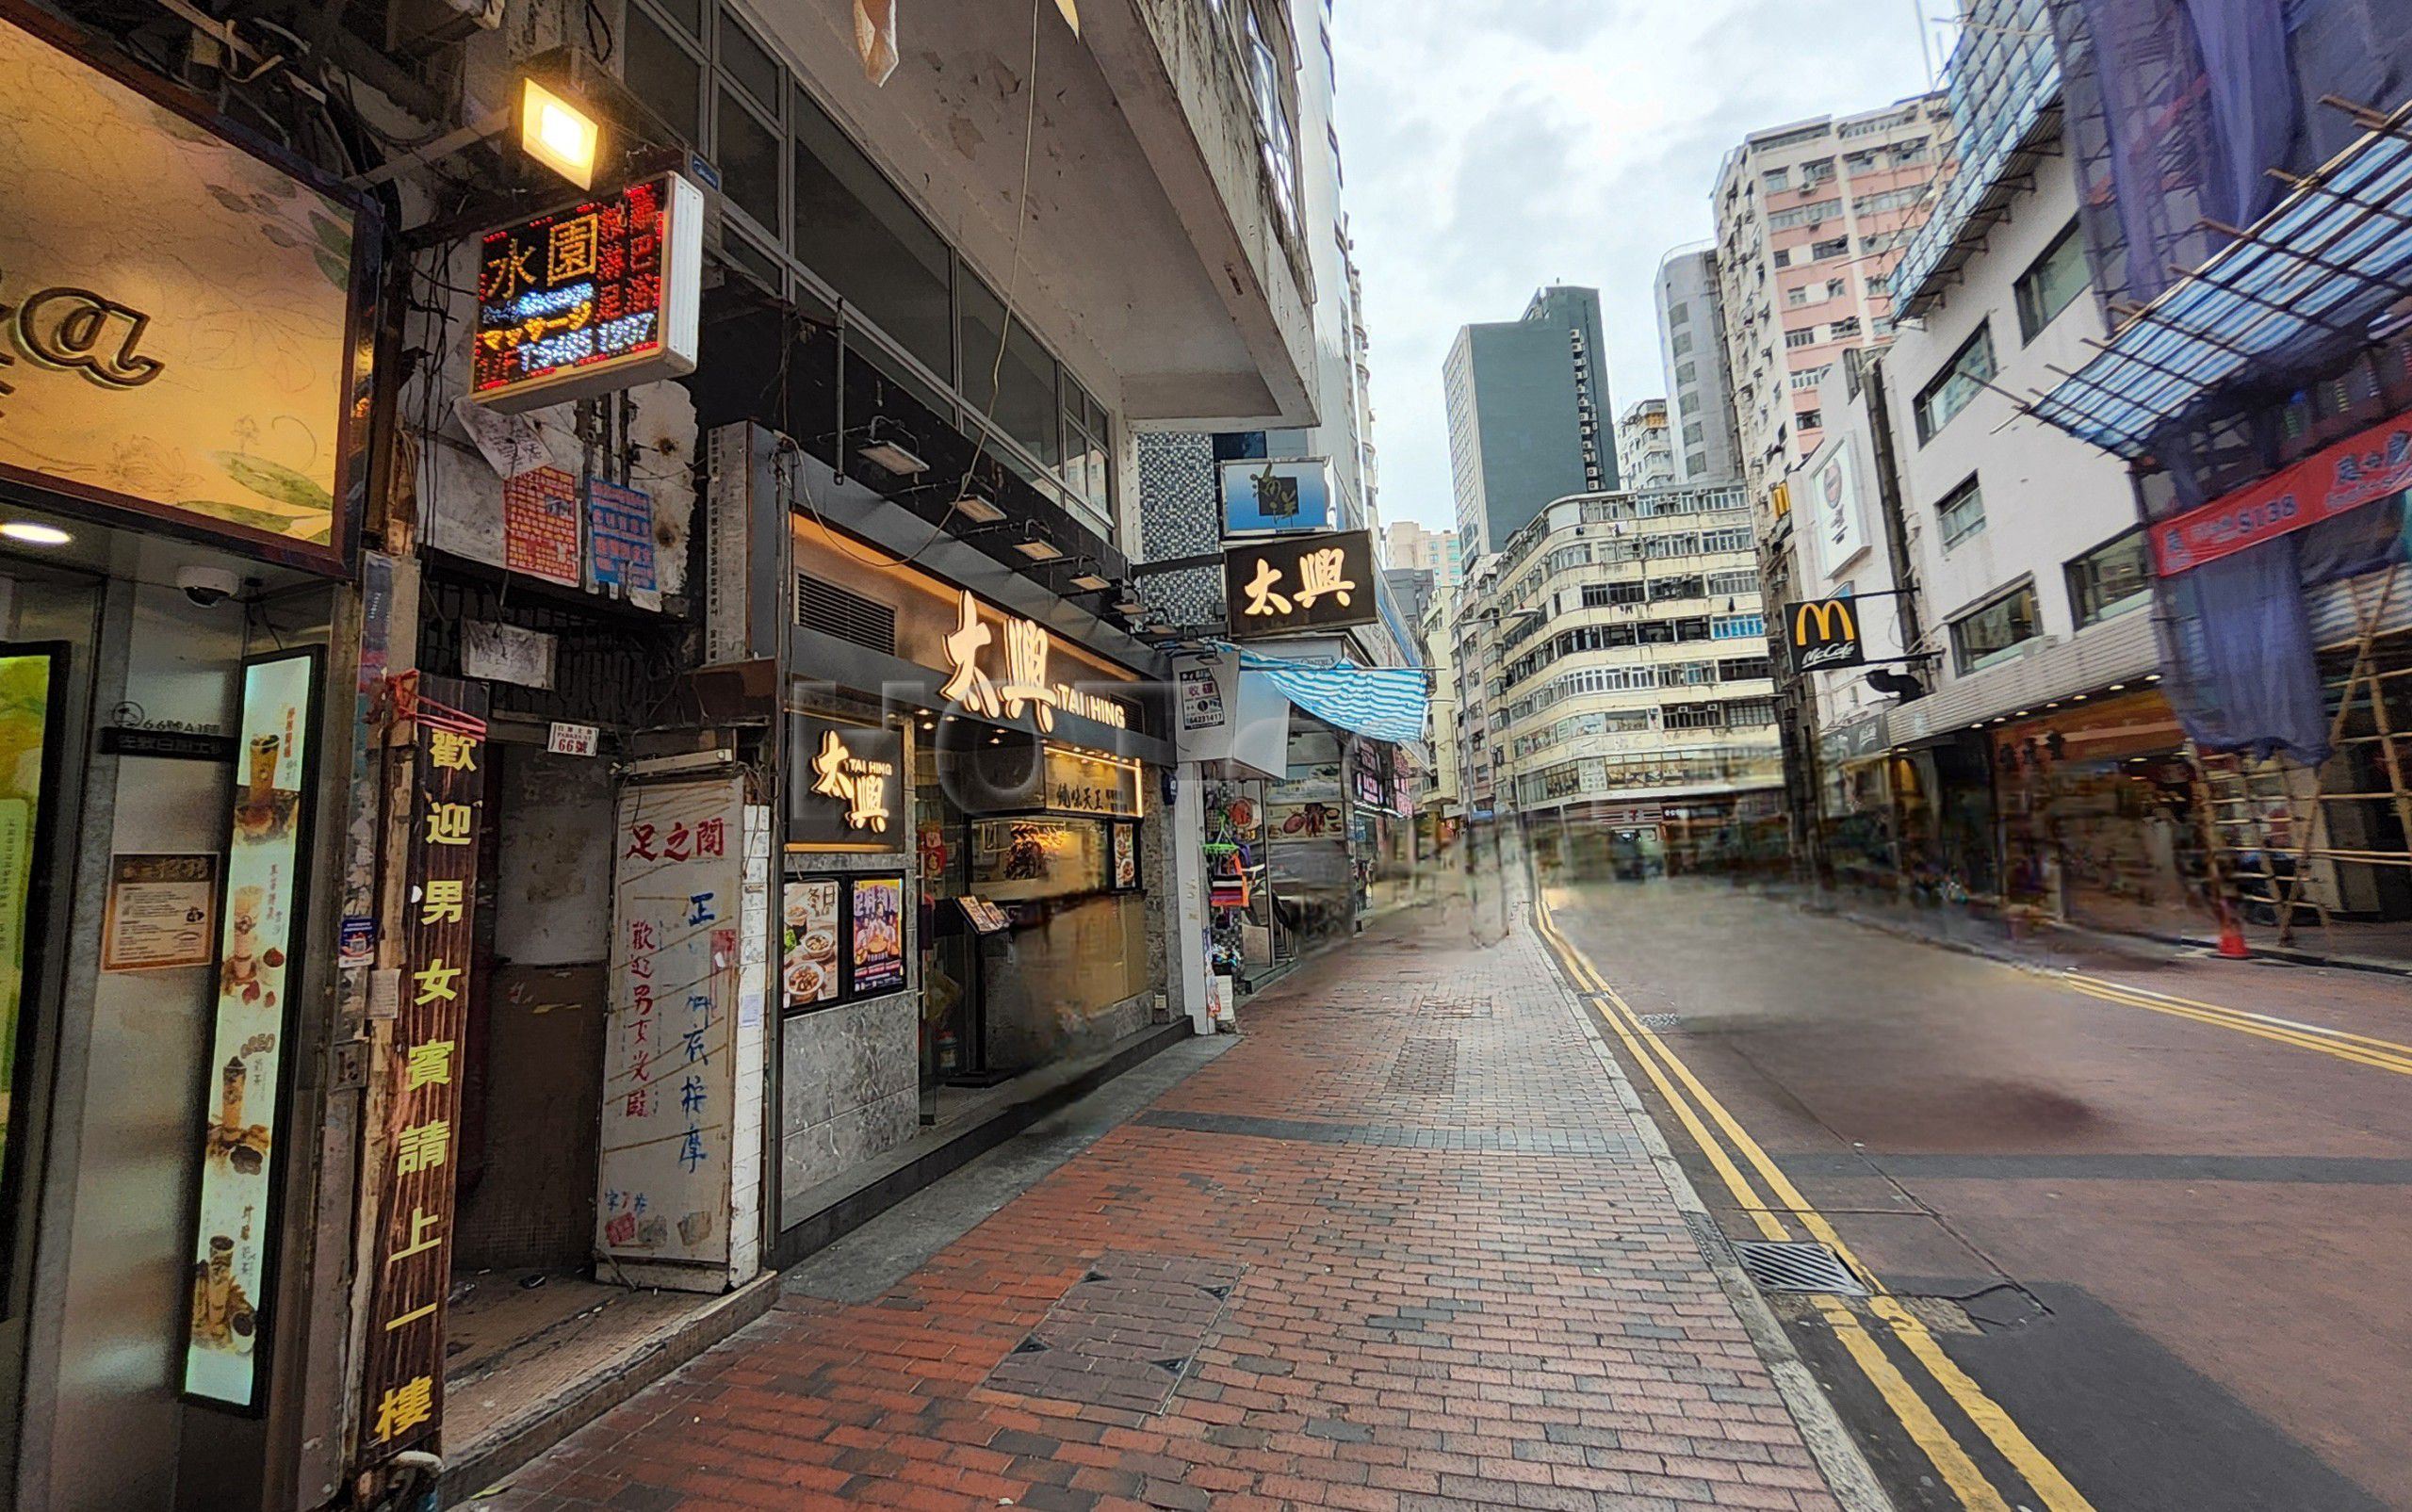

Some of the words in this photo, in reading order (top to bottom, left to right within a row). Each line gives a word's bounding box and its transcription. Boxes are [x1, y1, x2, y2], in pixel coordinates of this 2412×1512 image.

[486, 213, 599, 301] 水園
[1244, 547, 1357, 616] 太興
[939, 589, 1058, 734] 太興
[1052, 683, 1085, 716] TAI
[1085, 693, 1127, 729] HING
[810, 729, 890, 835] 太興
[844, 756, 867, 774] TAI
[868, 760, 893, 776] HING
